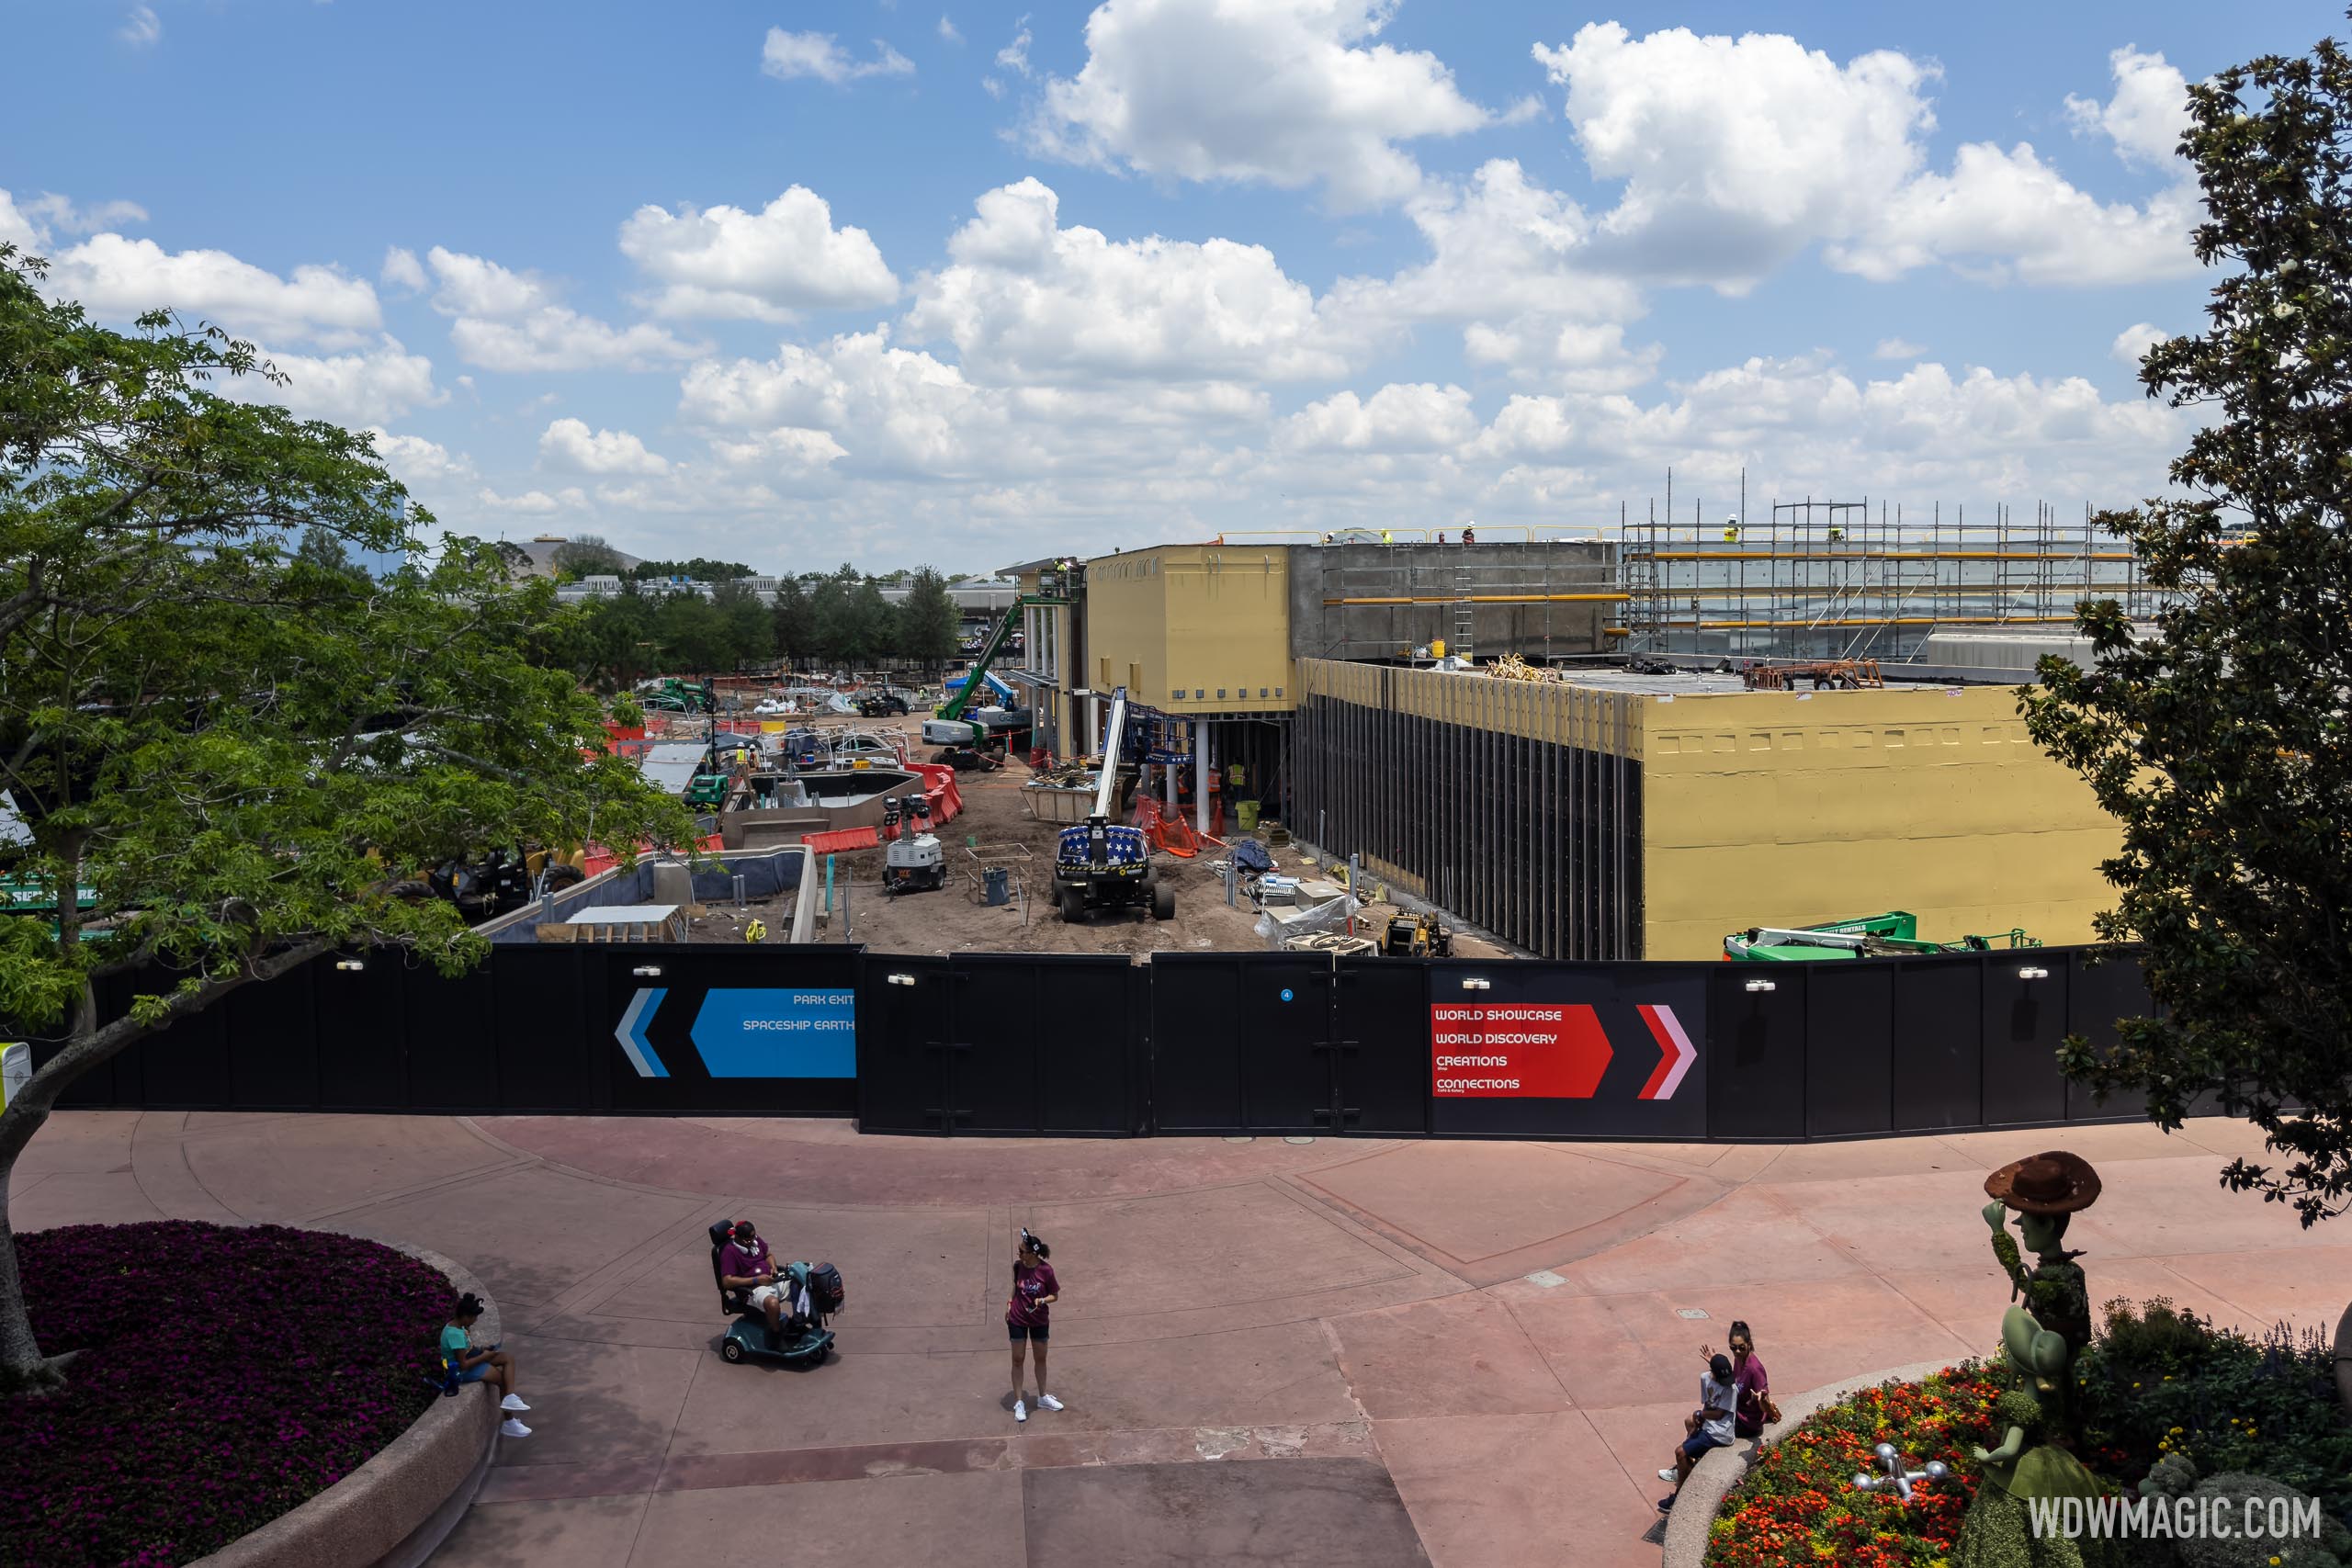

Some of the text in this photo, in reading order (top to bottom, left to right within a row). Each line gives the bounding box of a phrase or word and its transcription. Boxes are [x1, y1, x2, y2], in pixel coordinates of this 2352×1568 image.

[1839, 925, 1866, 933] RENTALS
[794, 995, 854, 1005] PARK EXIT
[1435, 1010, 1562, 1021] WORLD SHOWCASE
[743, 1021, 854, 1031] SPACESHIP EARTH
[1435, 1033, 1557, 1044] WORLD DISCOVERY
[1436, 1055, 1508, 1066] CREATIONS
[1437, 1078, 1521, 1089] CONNECTIONS
